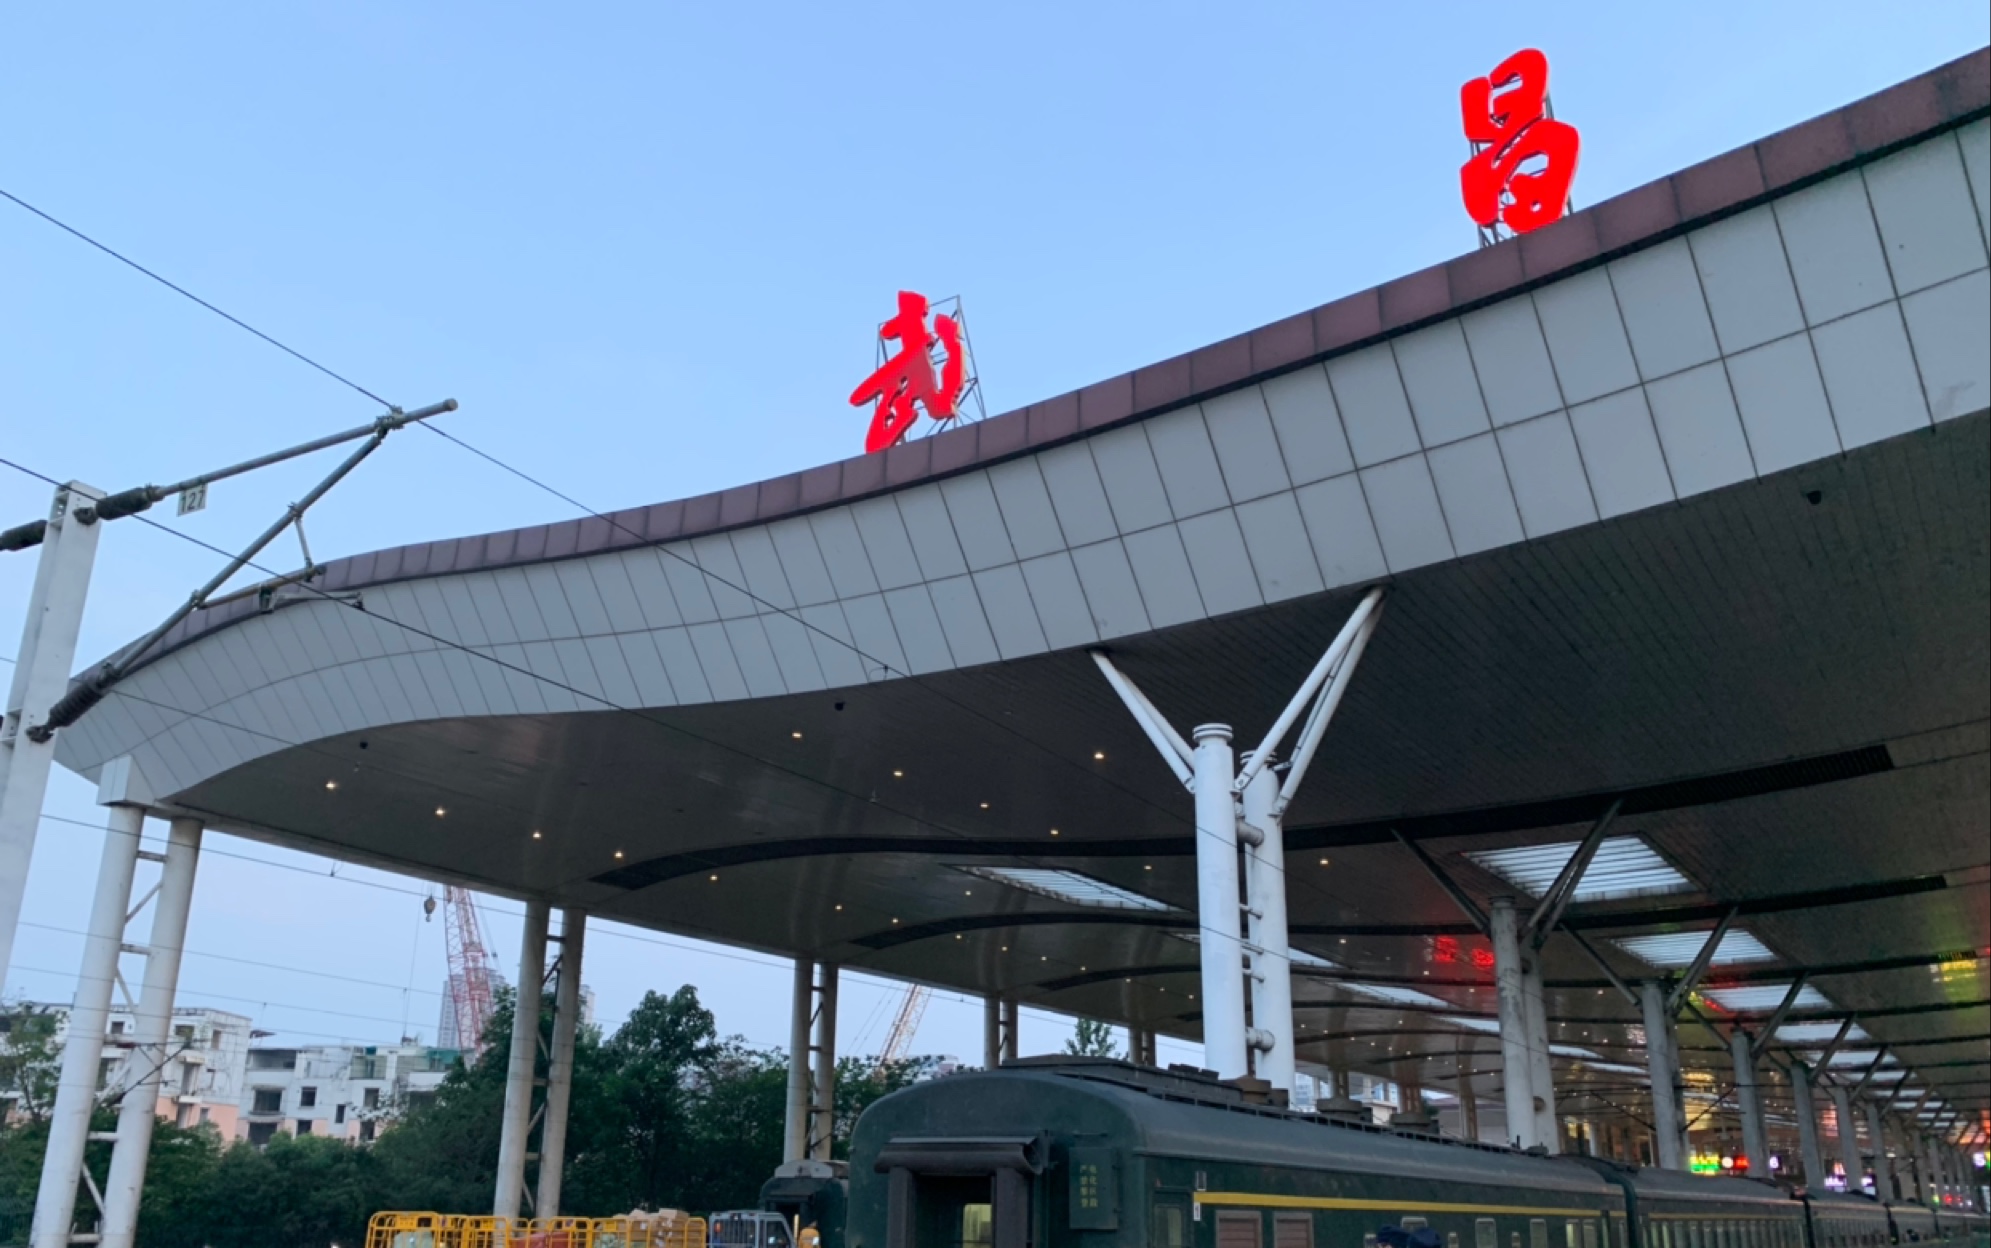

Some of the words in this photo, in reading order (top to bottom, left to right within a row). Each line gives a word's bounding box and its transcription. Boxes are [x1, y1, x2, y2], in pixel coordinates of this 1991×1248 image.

[849, 290, 964, 454] 武
[1459, 48, 1579, 234] 昌
[180, 488, 206, 512] 127
